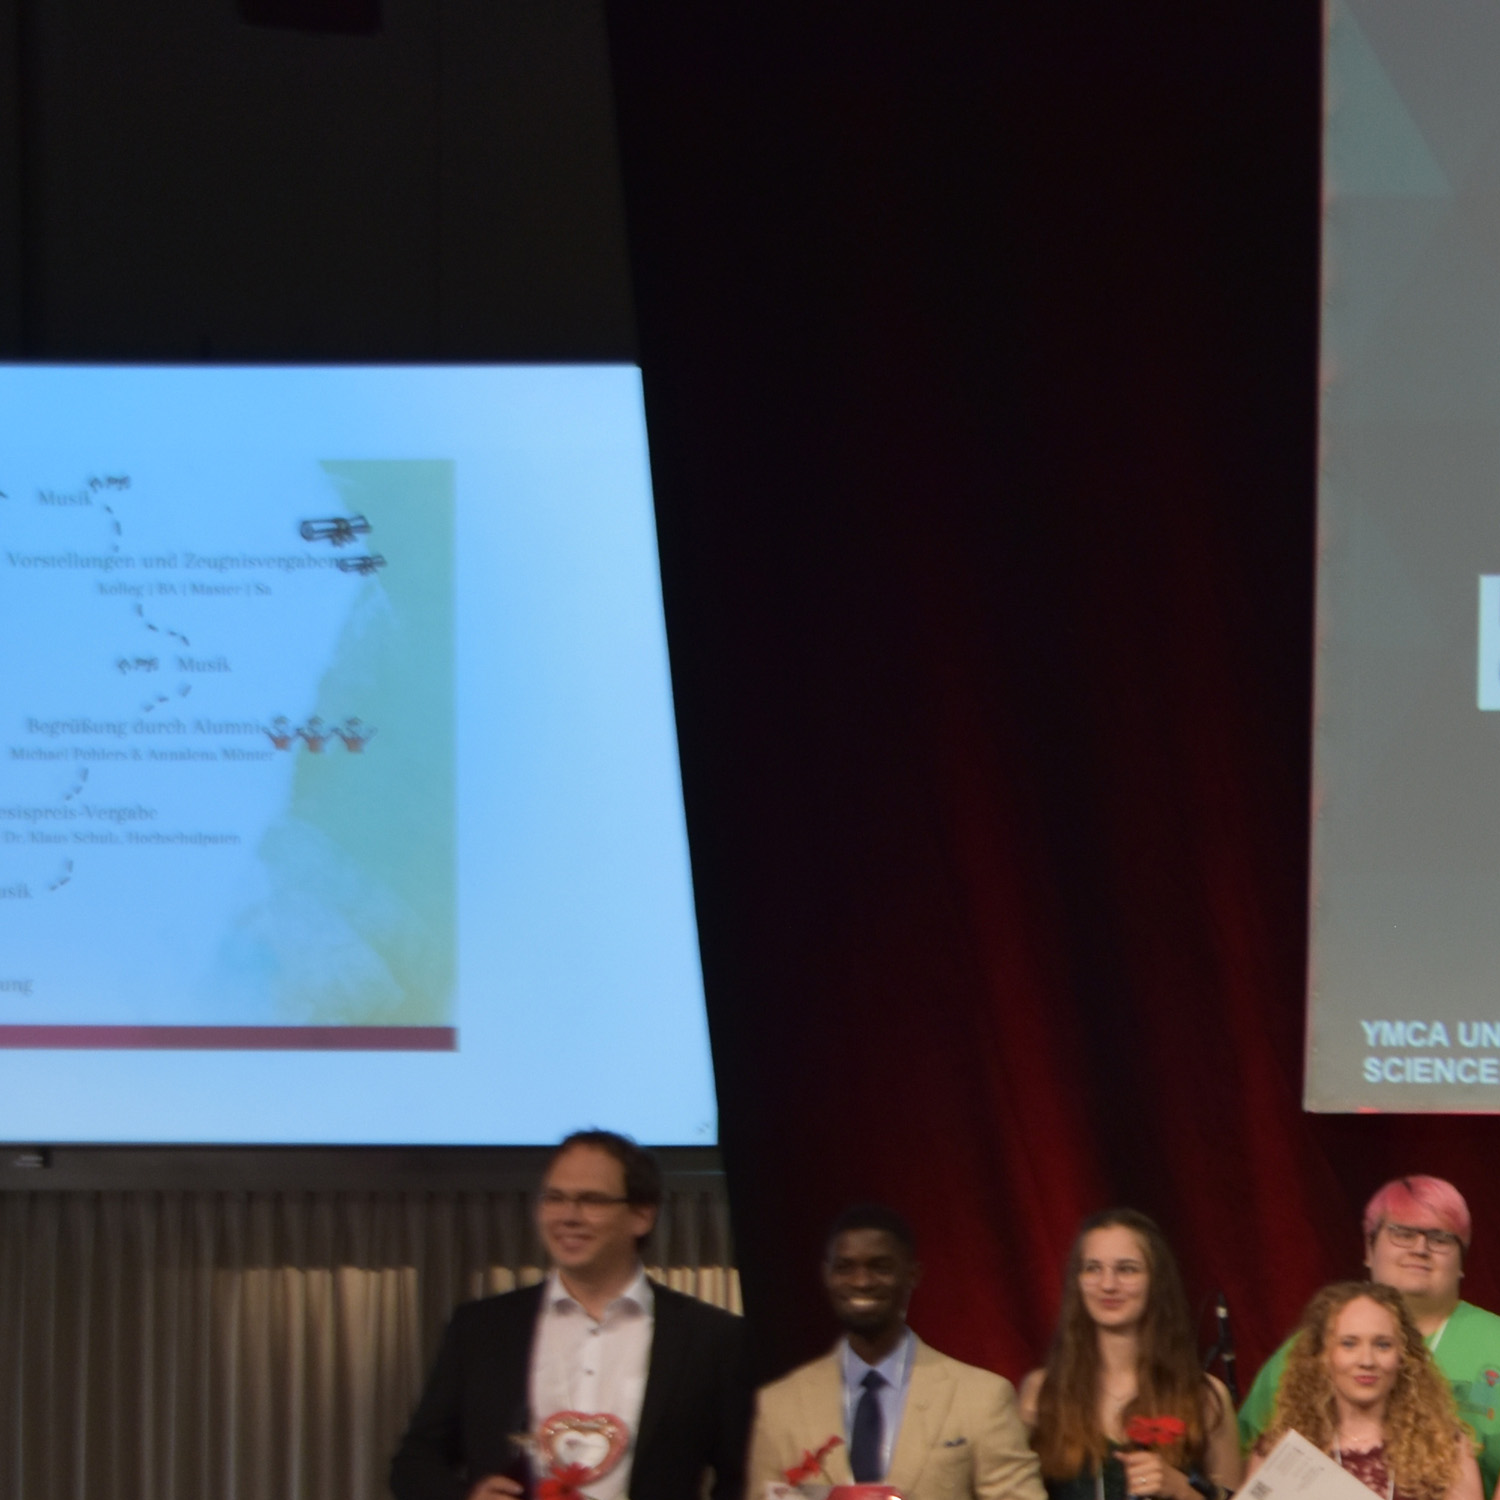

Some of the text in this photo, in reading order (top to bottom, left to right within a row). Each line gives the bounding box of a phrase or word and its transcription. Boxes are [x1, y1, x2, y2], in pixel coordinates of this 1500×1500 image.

[37, 488, 93, 507] Musik
[6, 551, 136, 571] Vorstellungen
[142, 551, 179, 569] und
[177, 654, 232, 673] Musik
[26, 715, 127, 738] Begrüßung
[132, 716, 187, 735] durch
[1361, 1021, 1449, 1047] YMCA
